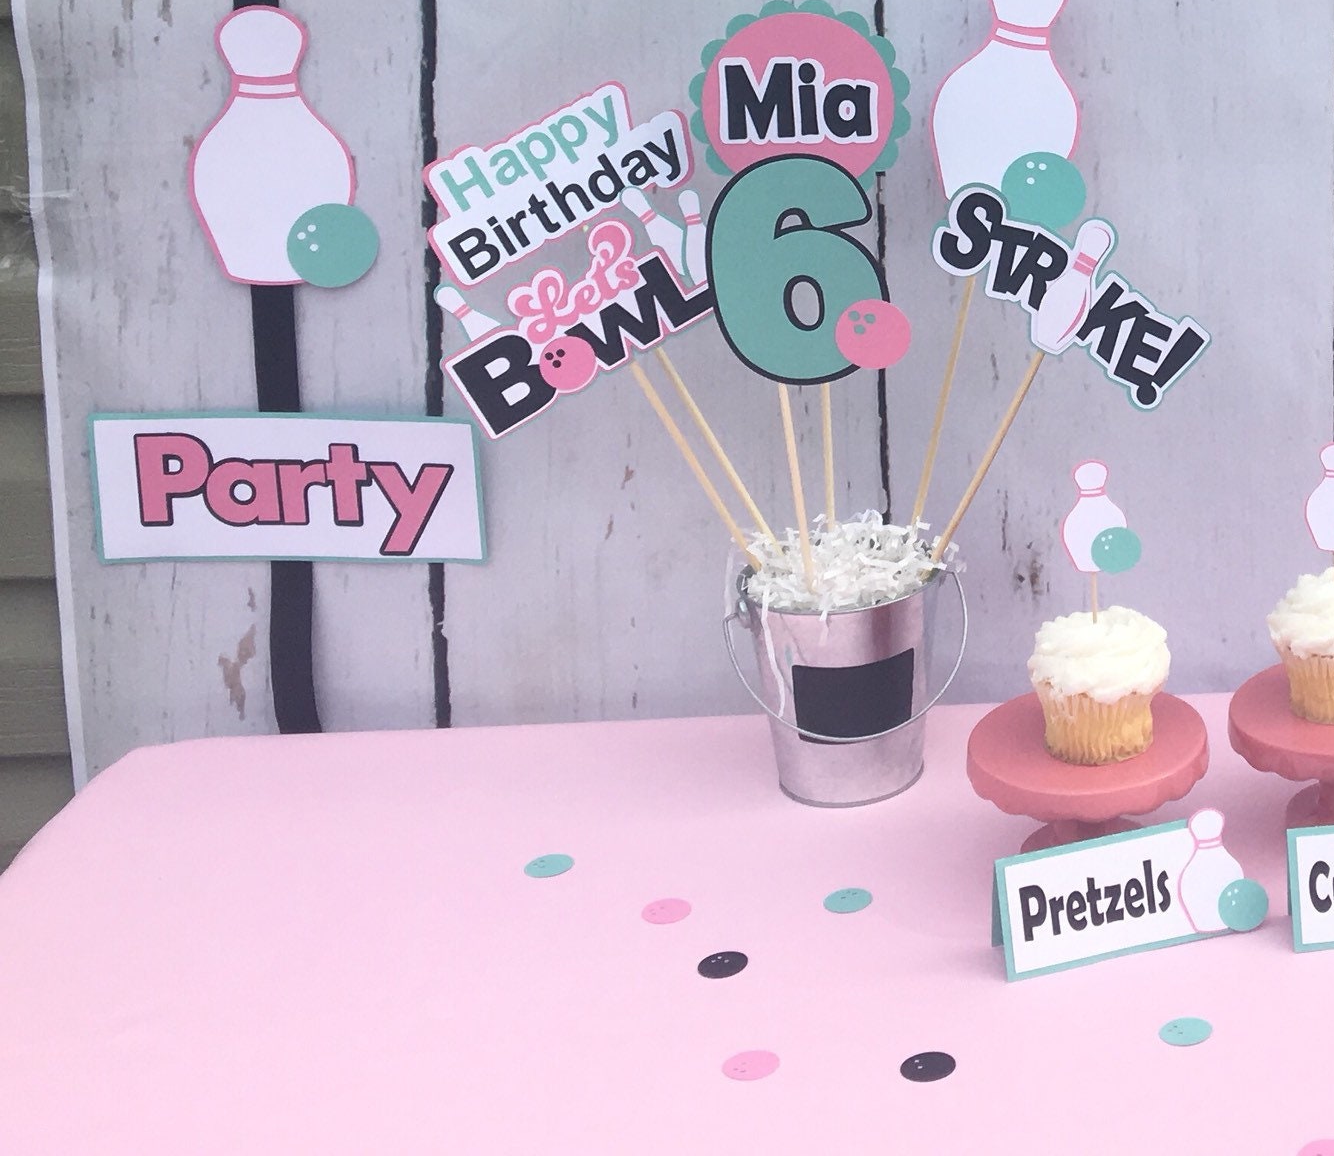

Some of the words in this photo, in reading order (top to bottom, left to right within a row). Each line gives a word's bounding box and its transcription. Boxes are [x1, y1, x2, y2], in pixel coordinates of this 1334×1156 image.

[440, 94, 620, 213] Happy
[724, 62, 872, 141] Mia
[447, 128, 682, 281] Birthday
[511, 220, 640, 344] Let's
[704, 152, 891, 386] 6
[133, 432, 454, 556] Party
[1018, 858, 1172, 942] Pretzels
